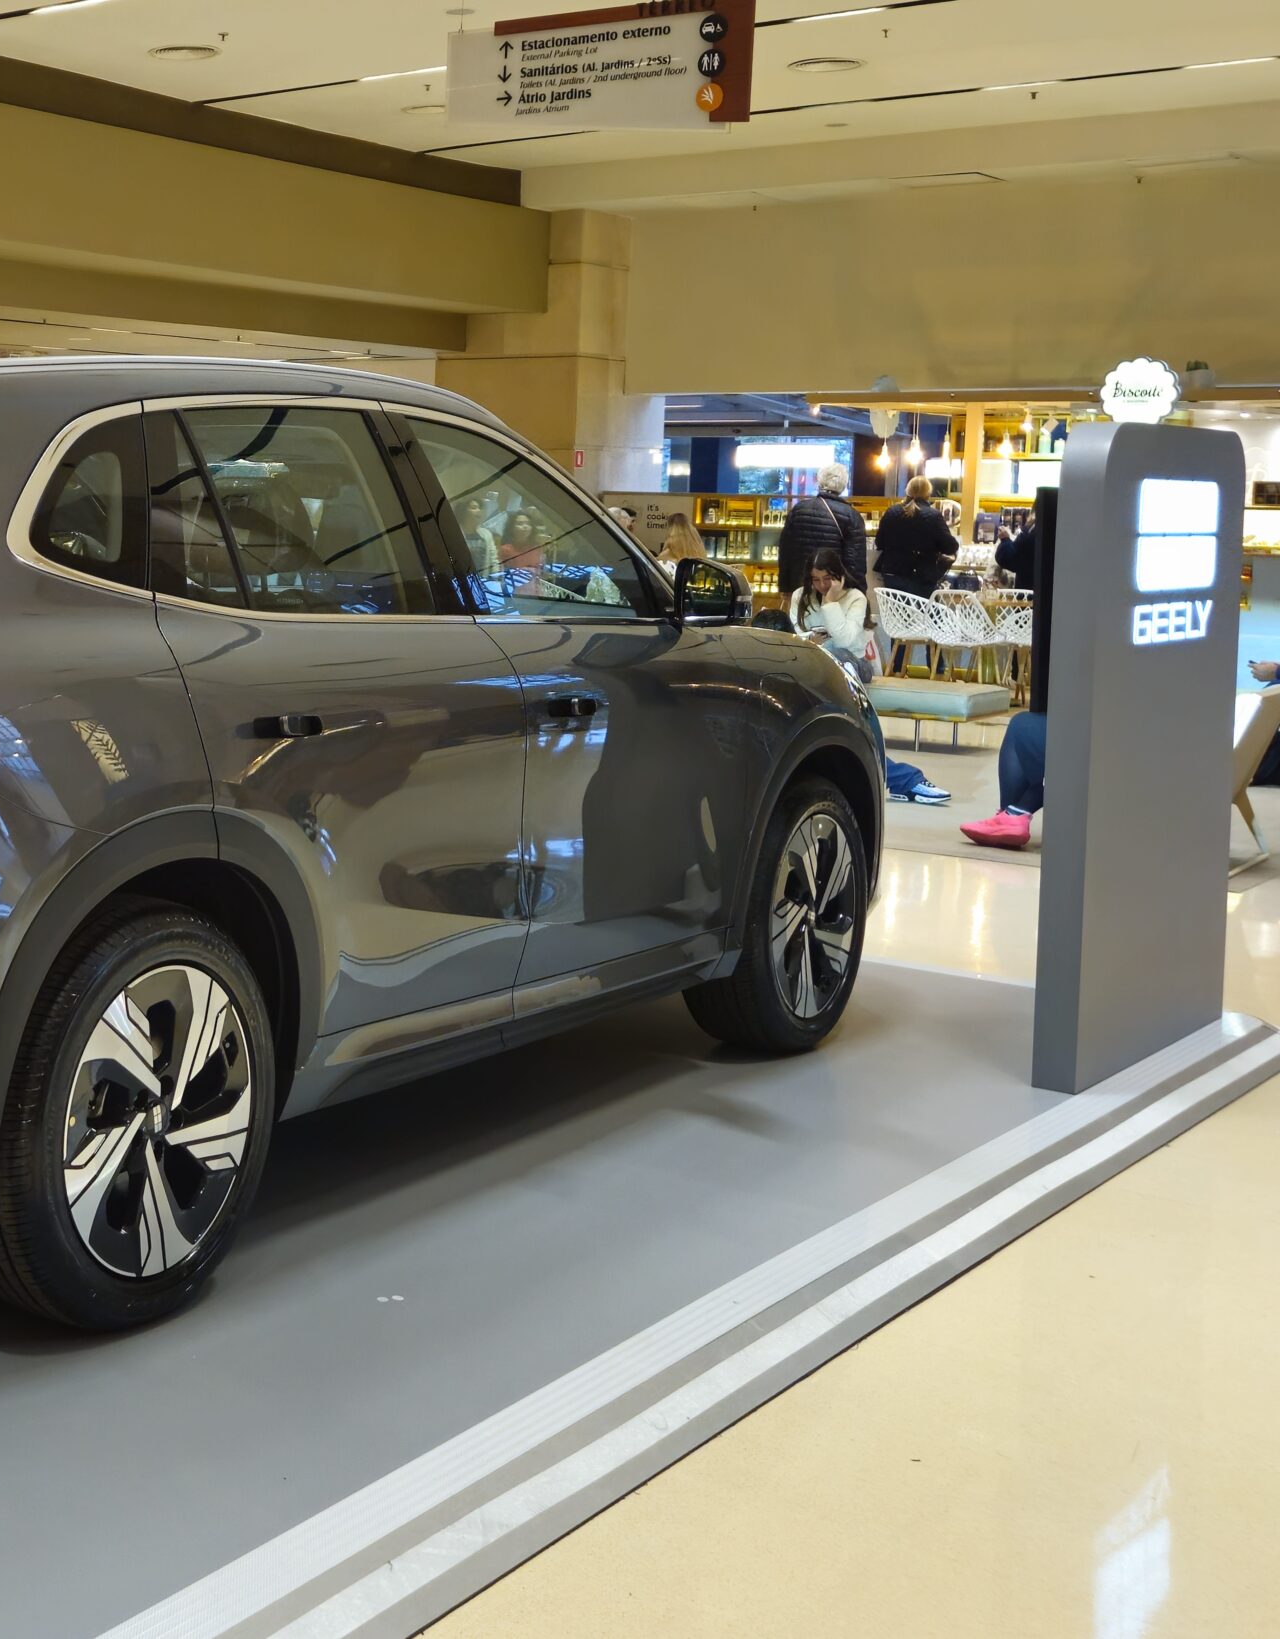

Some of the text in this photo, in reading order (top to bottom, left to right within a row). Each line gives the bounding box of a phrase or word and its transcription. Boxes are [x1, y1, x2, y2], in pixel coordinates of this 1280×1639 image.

[521, 25, 671, 51] Estacionamento externo
[521, 46, 598, 62] External Parking Lot
[520, 63, 578, 78] Sanitários
[582, 62, 598, 73] (Al.
[600, 59, 635, 73] Jardins
[520, 80, 543, 89] Toilets
[558, 76, 585, 87] Jardins
[593, 73, 609, 83] 2nd
[610, 69, 662, 81] underground
[663, 66, 688, 76] floor)
[518, 88, 592, 105] Átrio Jardins
[515, 104, 570, 117] Jardins Atrium
[1132, 599, 1214, 646] GEELY
